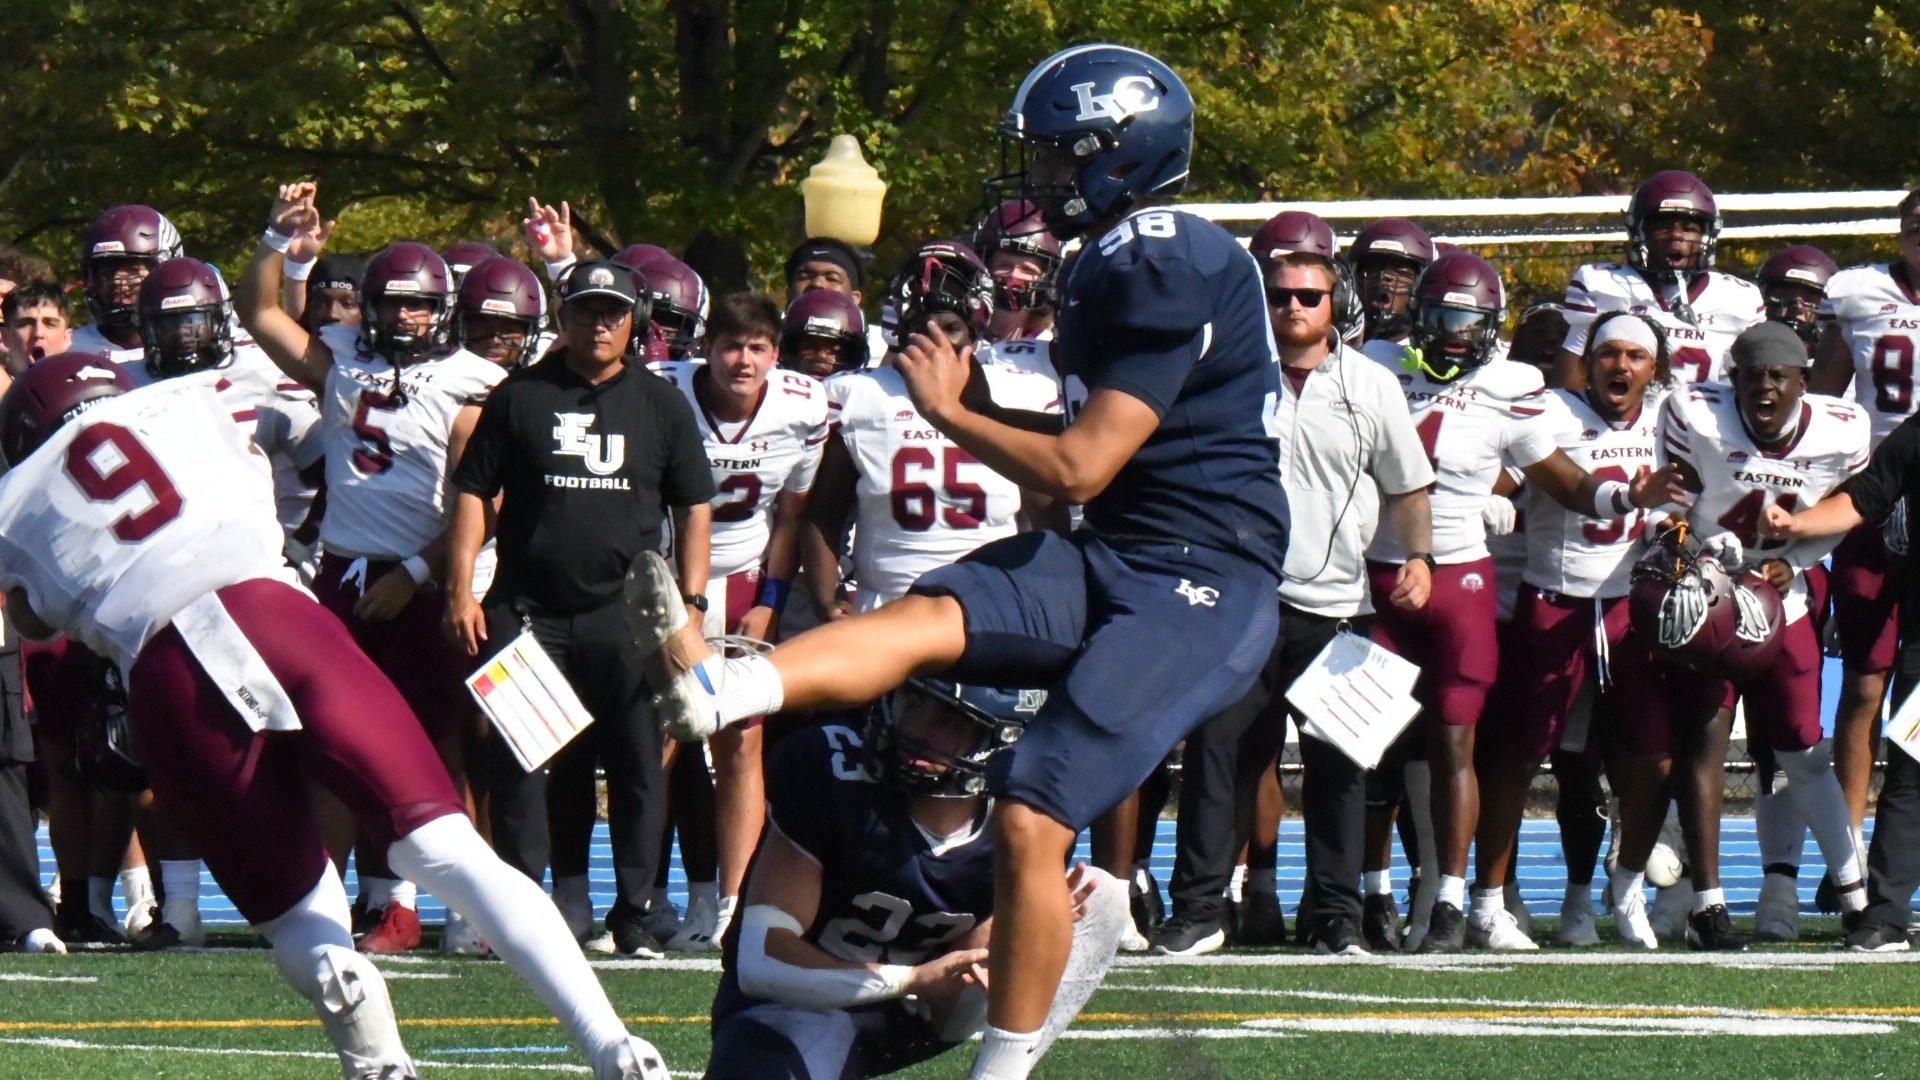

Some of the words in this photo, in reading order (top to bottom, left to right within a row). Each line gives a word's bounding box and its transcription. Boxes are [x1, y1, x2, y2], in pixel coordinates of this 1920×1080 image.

[331, 281, 353, 290] BOO
[1667, 328, 1705, 341] TERN
[355, 372, 419, 395] EASTRN
[783, 375, 812, 400] 12
[1405, 391, 1466, 411] ASTERN
[352, 391, 395, 474] 5
[552, 412, 625, 476] EU
[1590, 447, 1654, 460] EASTERN
[710, 458, 761, 470] STERN
[62, 421, 184, 545] 9
[544, 475, 632, 490] FOOTBALL
[1733, 471, 1803, 487] EASTERN
[891, 447, 987, 532] 65
